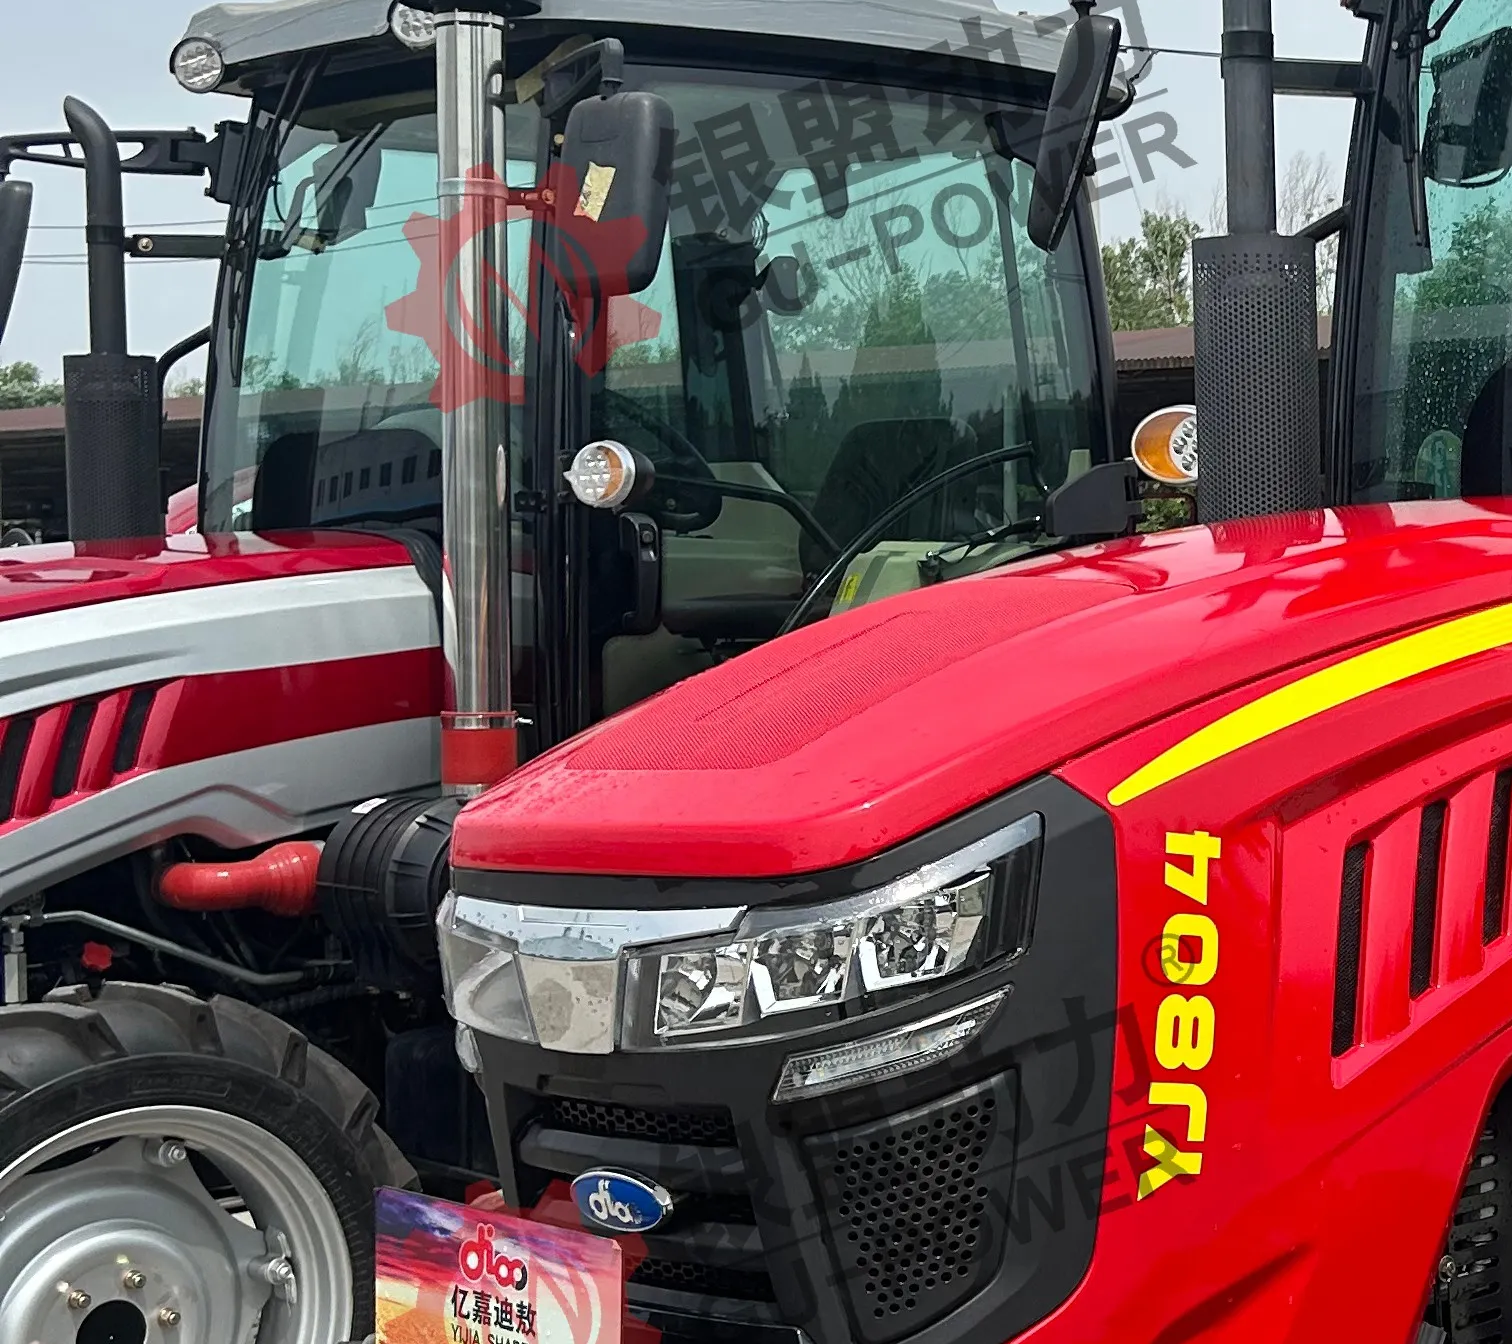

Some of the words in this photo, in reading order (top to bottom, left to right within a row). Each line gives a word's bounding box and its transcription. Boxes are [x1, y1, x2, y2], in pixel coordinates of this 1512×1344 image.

[1136, 830, 1222, 1202] YJ804
[451, 1284, 537, 1338] 亿嘉迪敖
